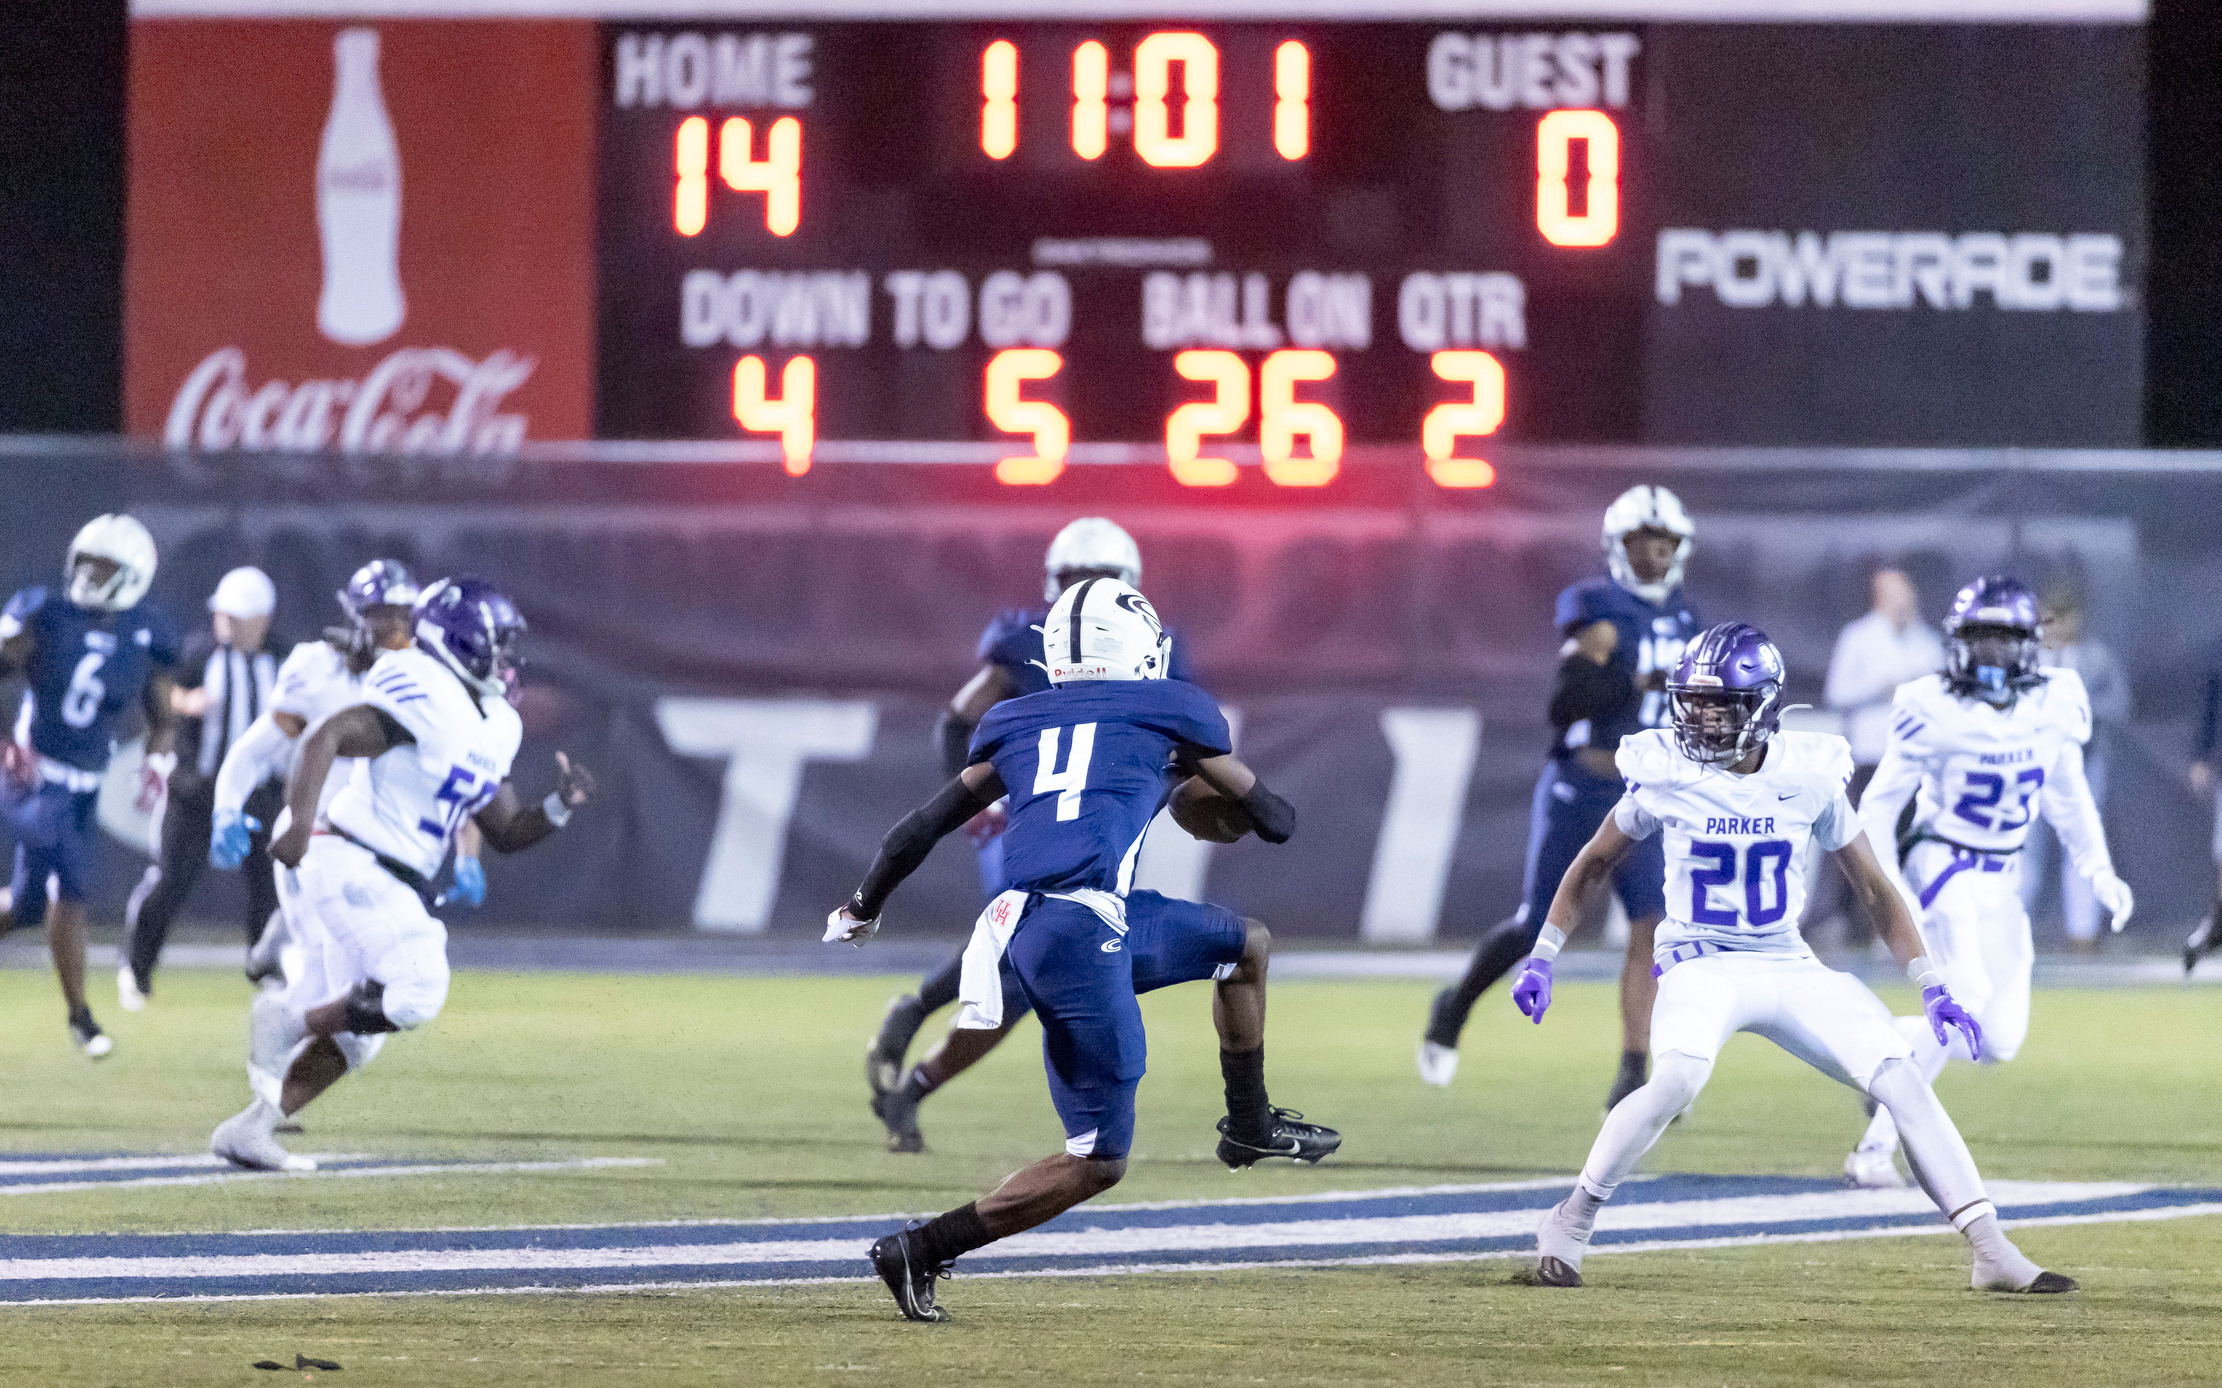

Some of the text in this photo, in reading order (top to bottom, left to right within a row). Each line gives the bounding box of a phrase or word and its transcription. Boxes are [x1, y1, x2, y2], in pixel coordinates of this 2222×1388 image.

[614, 33, 815, 107] HOME
[1428, 32, 1640, 111] GUEST
[676, 116, 801, 237] 14
[1537, 108, 1619, 247] 0
[681, 270, 871, 347] DOWN
[887, 271, 1072, 348] TO GO
[1142, 272, 1372, 350] BALL ON
[1400, 272, 1527, 350] QTR
[1656, 229, 2123, 311] POWERADE
[733, 355, 816, 477] 4
[985, 349, 1070, 486] 5
[1166, 349, 1344, 487] 26
[1423, 350, 1506, 488] 2
[62, 652, 105, 728] 6
[1032, 722, 1098, 822] 4
[1706, 817, 1775, 835] PARKER
[1689, 839, 1793, 927] 20
